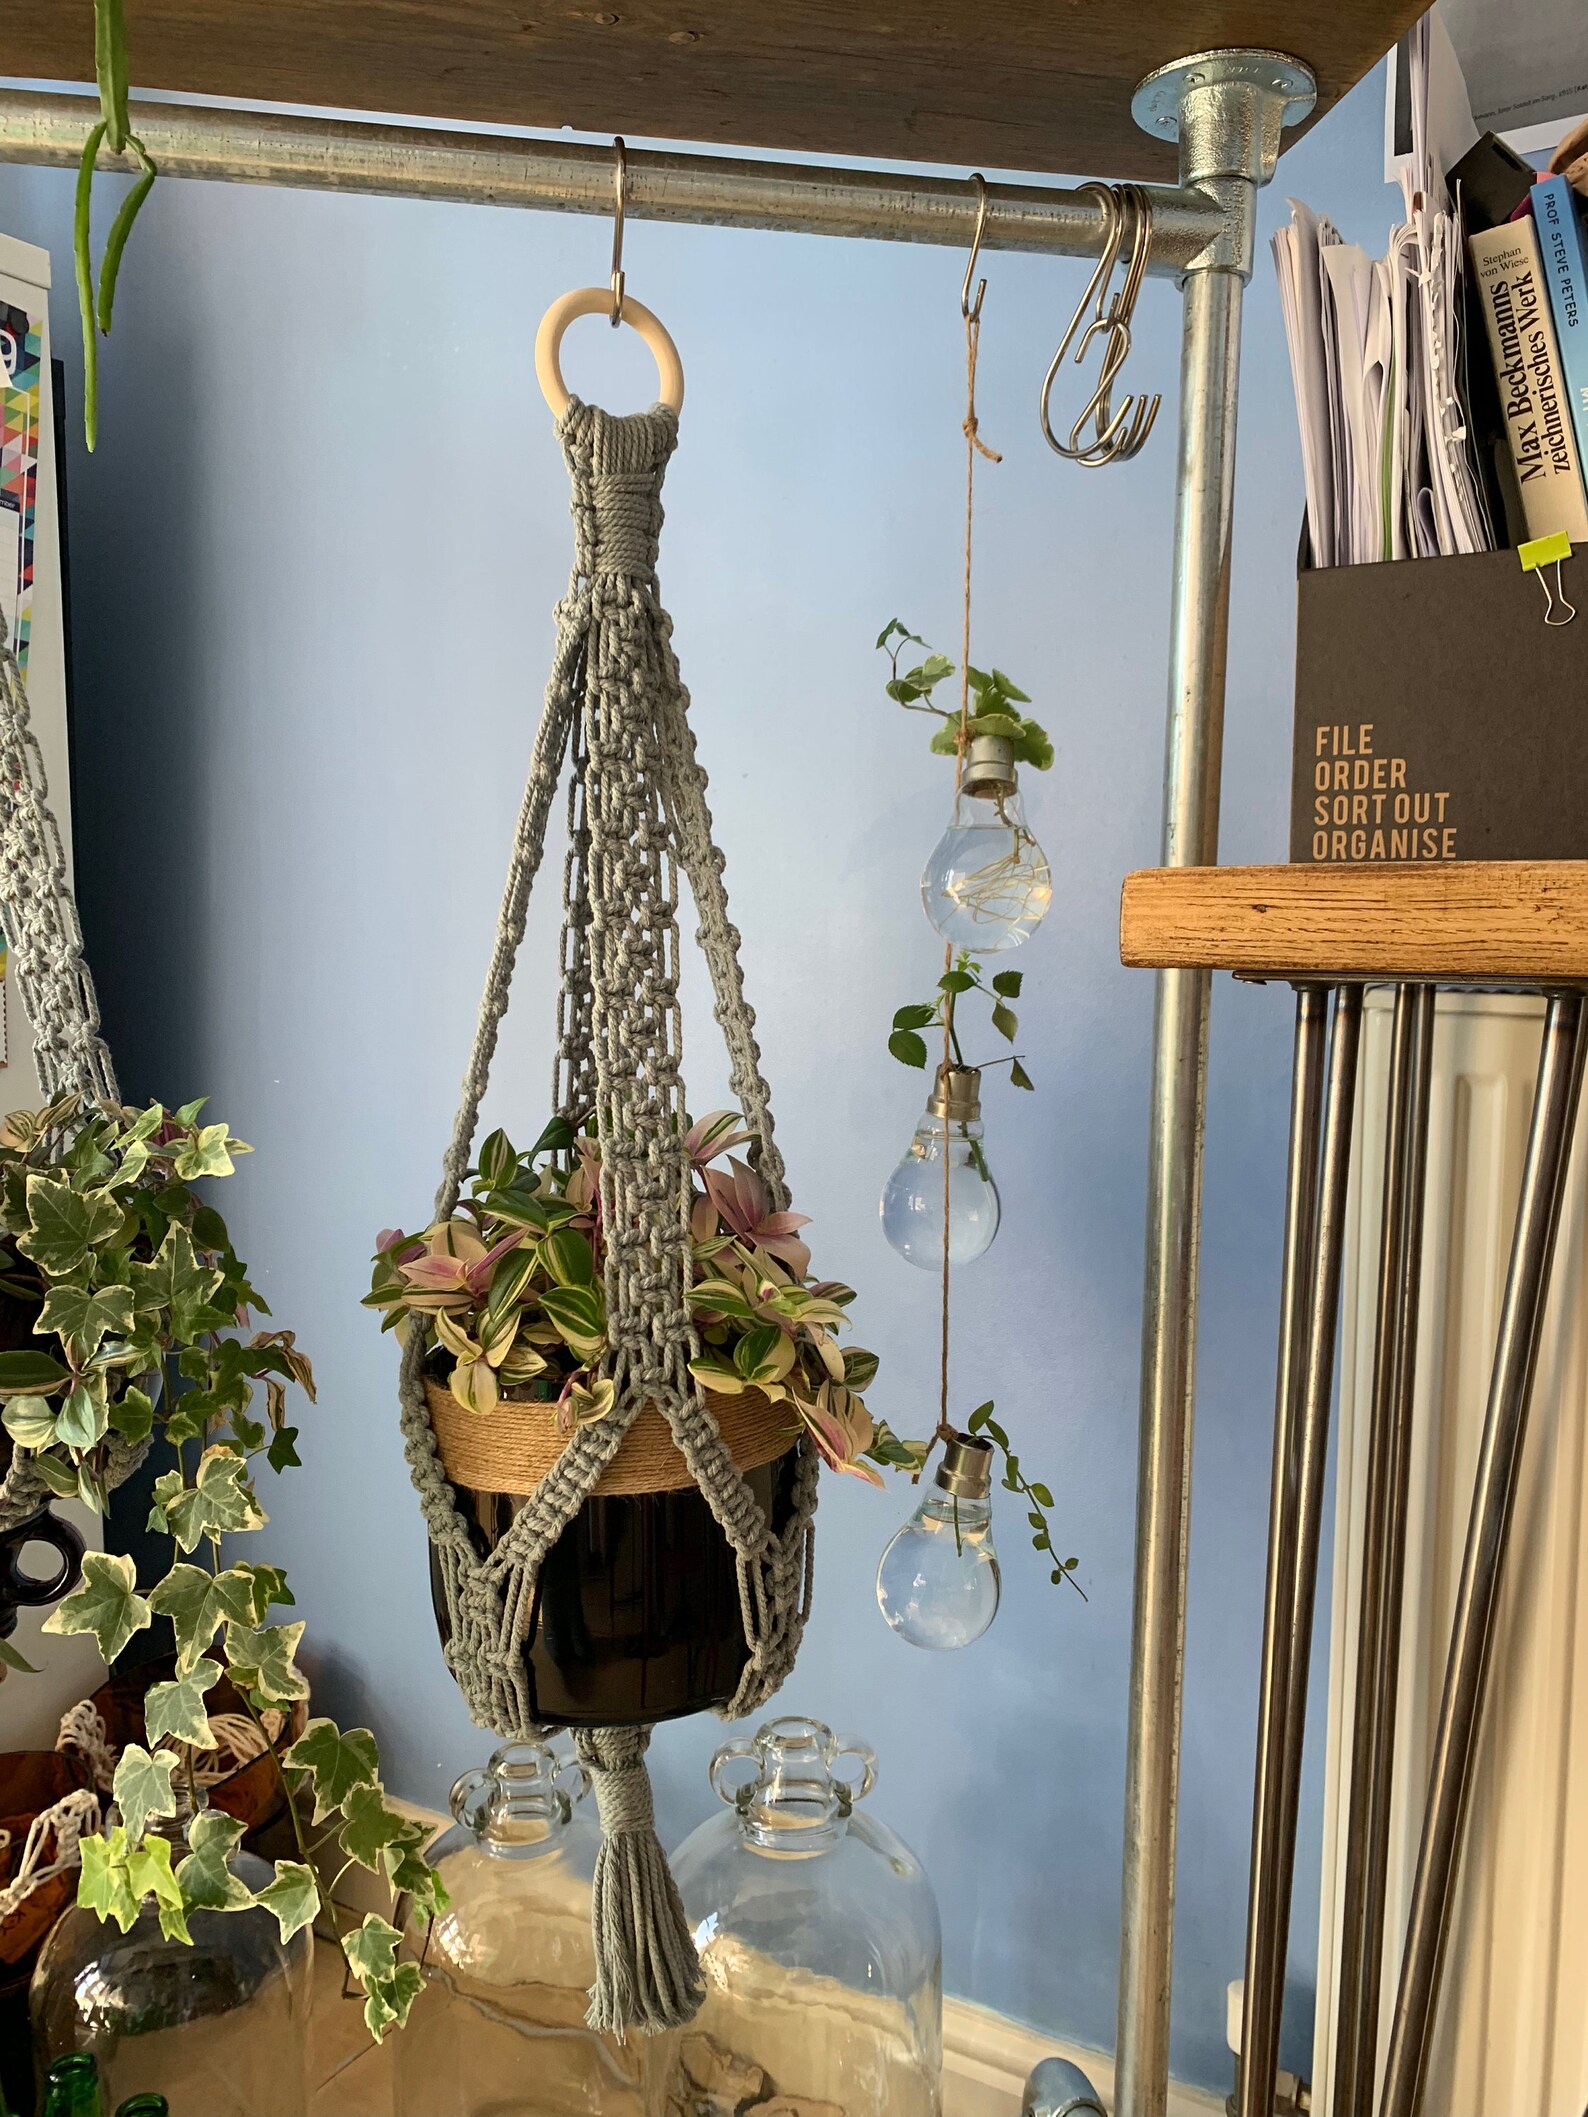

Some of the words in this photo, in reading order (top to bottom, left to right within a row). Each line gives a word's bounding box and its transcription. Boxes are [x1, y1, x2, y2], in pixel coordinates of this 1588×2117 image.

[1544, 193, 1559, 225] PROF
[1480, 267, 1498, 279] von
[1500, 256, 1530, 272] Wiese
[1482, 247, 1522, 267] Stephan
[1551, 232, 1569, 274] STEVE
[1511, 270, 1539, 334] Werk
[1561, 277, 1579, 328] PETERS
[1490, 280, 1534, 421] Beckmanns
[1527, 330, 1571, 475] zeichnerisches
[1516, 420, 1546, 485] Max
[1315, 723, 1374, 756] FILE
[1314, 758, 1407, 791] ORDER
[1313, 794, 1387, 826] SORT
[1394, 792, 1450, 824] OUT
[1312, 828, 1458, 860] ORGANISE
